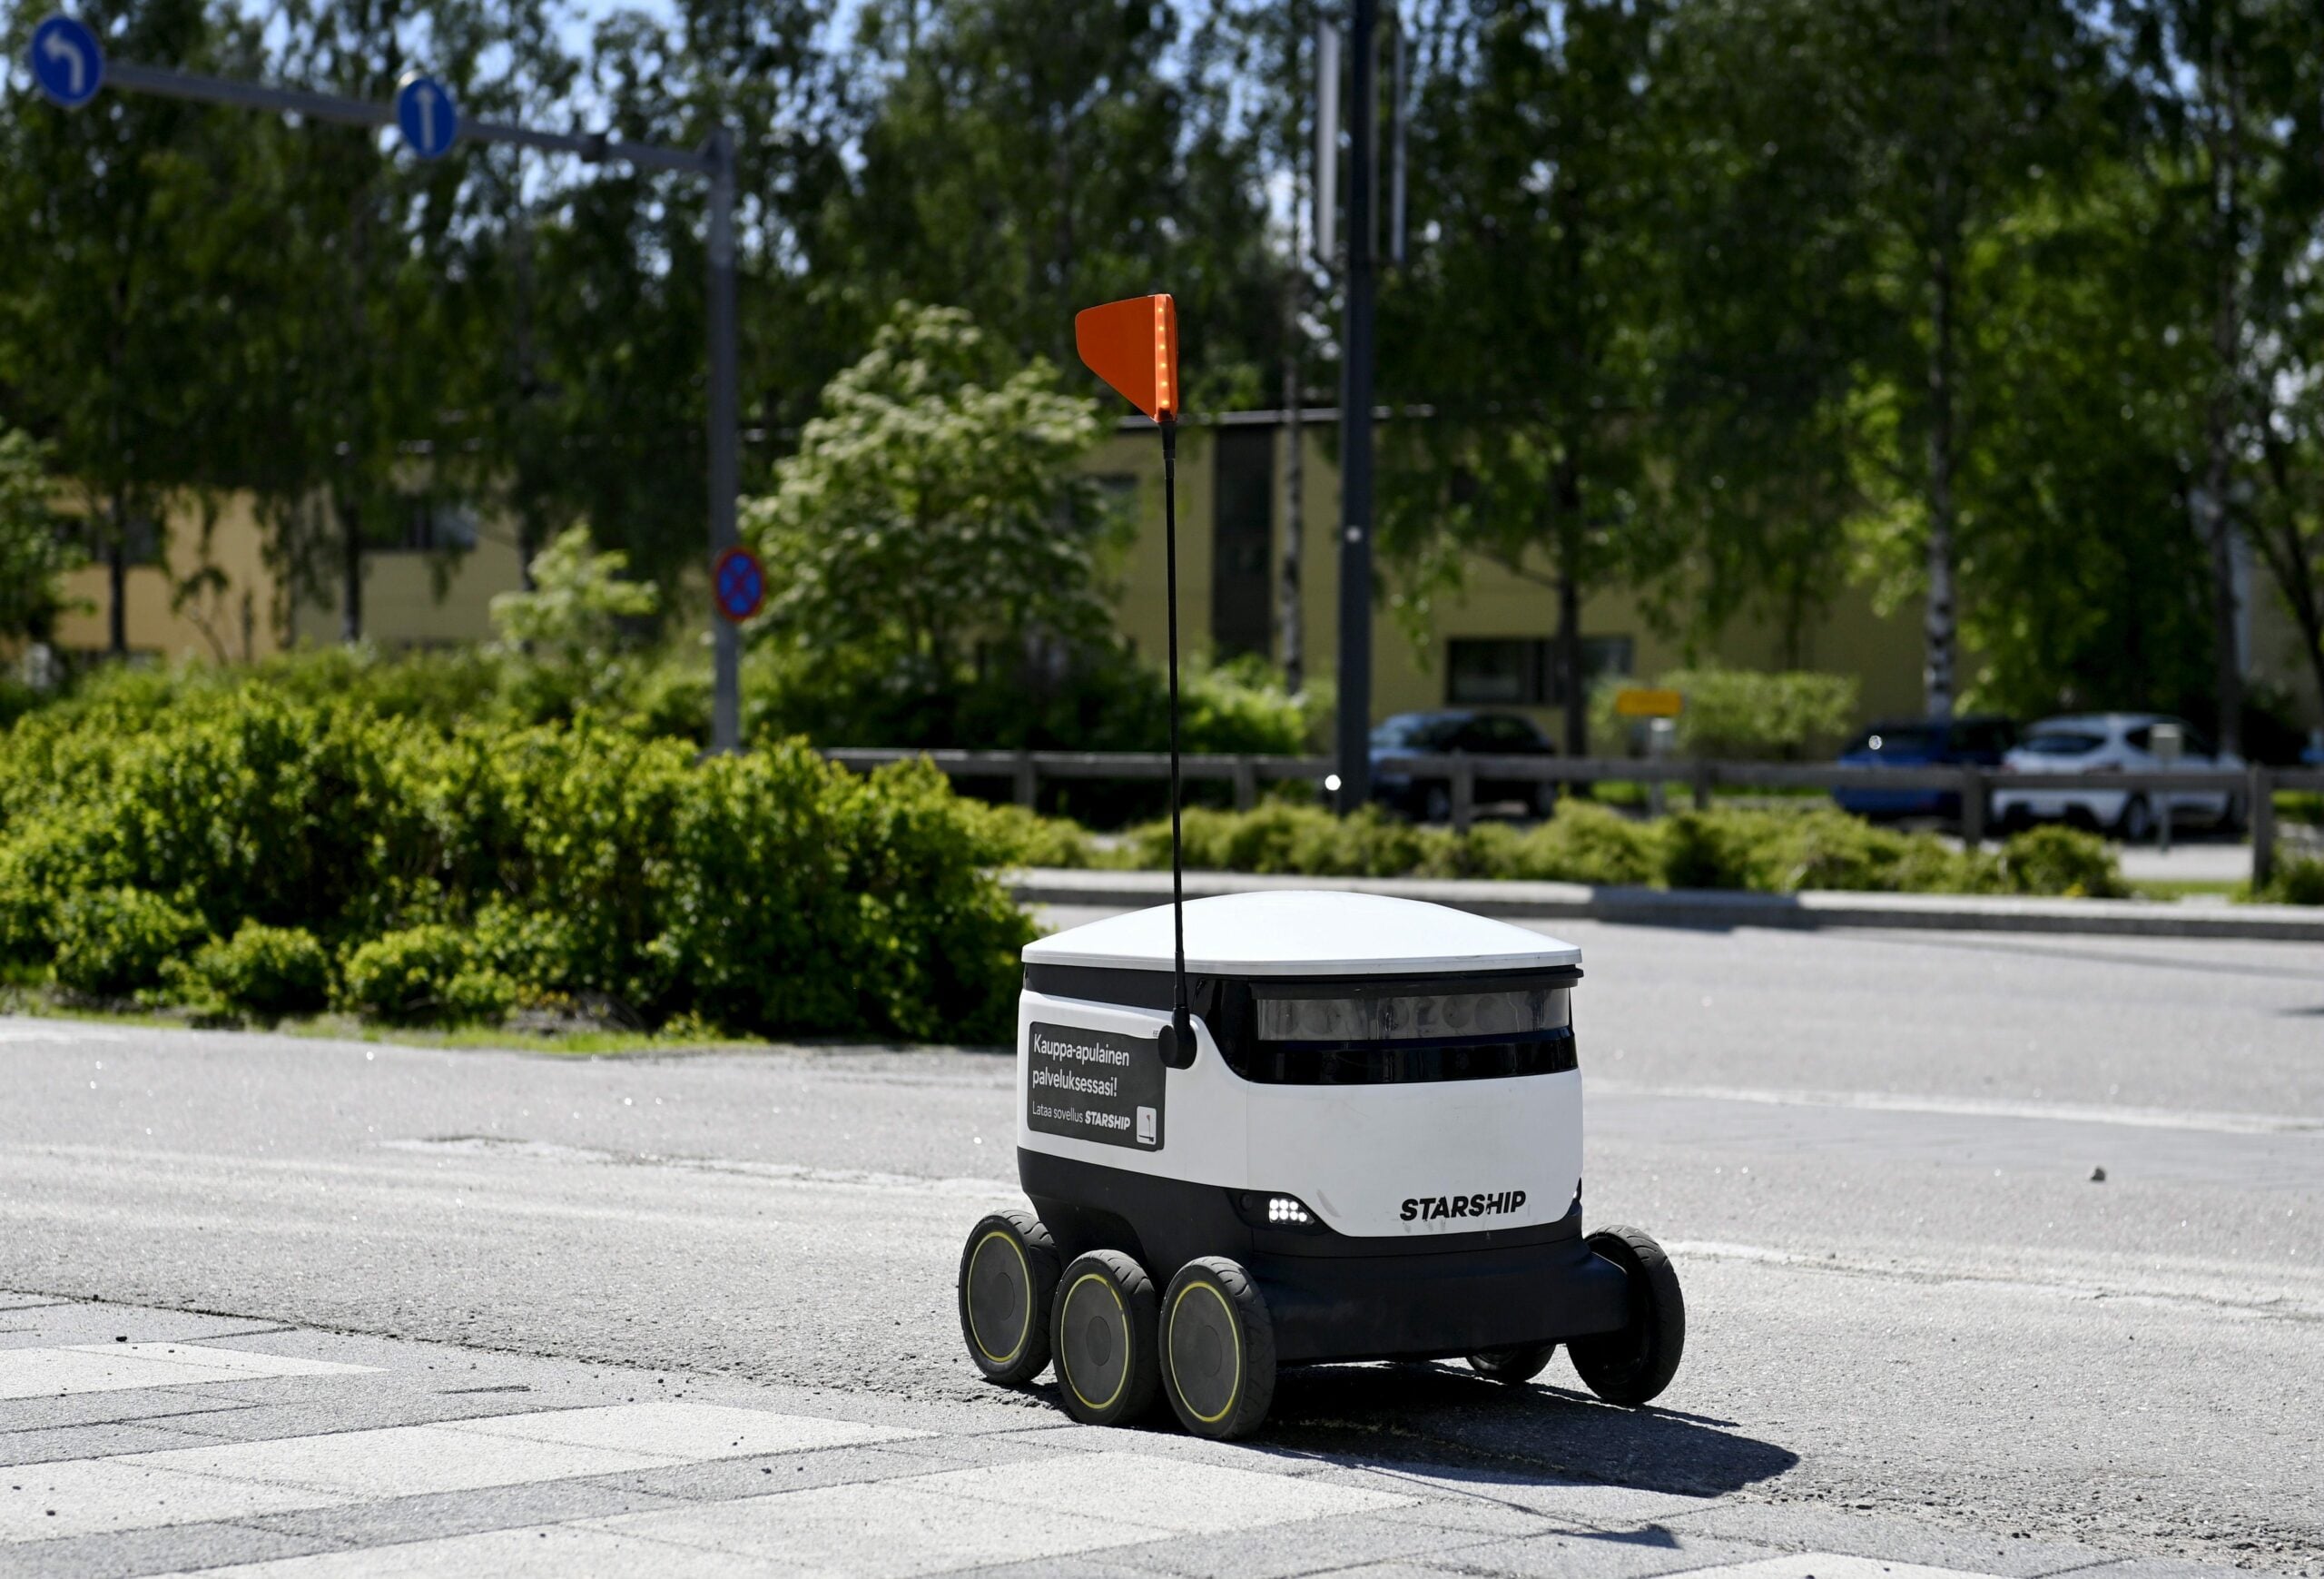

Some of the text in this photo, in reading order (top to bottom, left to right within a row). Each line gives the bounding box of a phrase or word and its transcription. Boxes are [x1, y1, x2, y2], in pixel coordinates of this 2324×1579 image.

[1033, 1033, 1129, 1067] Kauppa-apulainen
[1032, 1066, 1118, 1097] palveluksessasi!
[1032, 1100, 1131, 1130] Lataa sovellus STARSHIP
[1400, 1190, 1527, 1221] STARSHIP
